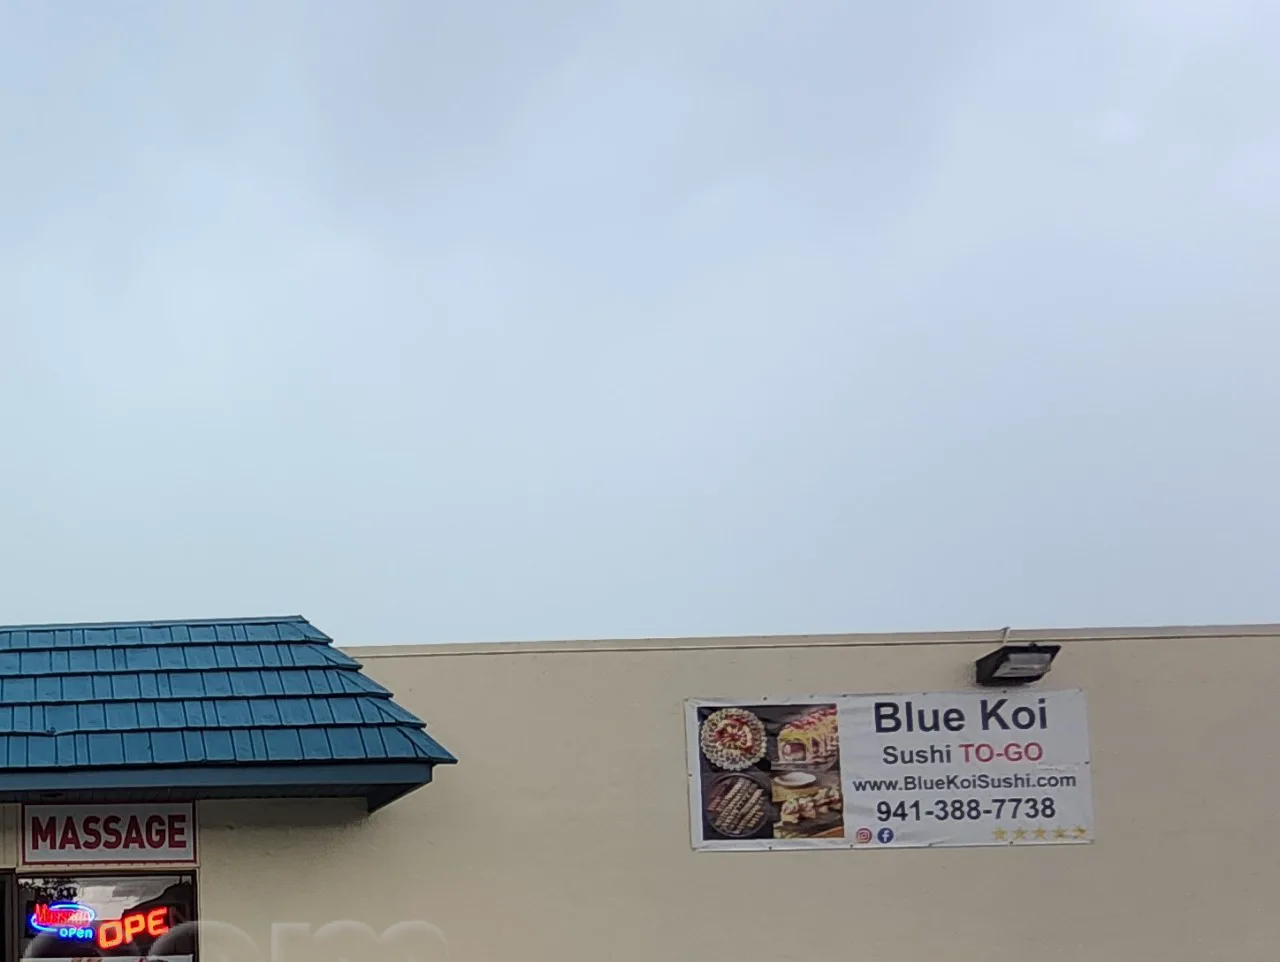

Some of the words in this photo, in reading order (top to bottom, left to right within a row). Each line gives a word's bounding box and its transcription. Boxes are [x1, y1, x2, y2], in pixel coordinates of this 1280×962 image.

[874, 701, 965, 733] Blue
[980, 698, 1048, 731] Koi
[882, 744, 952, 765] Sushi
[958, 741, 1043, 764] TO-GO
[853, 773, 1077, 793] www.BlueKoiSushi.com
[876, 797, 1056, 822] 941-388-7738
[31, 814, 187, 850] MASSAGE
